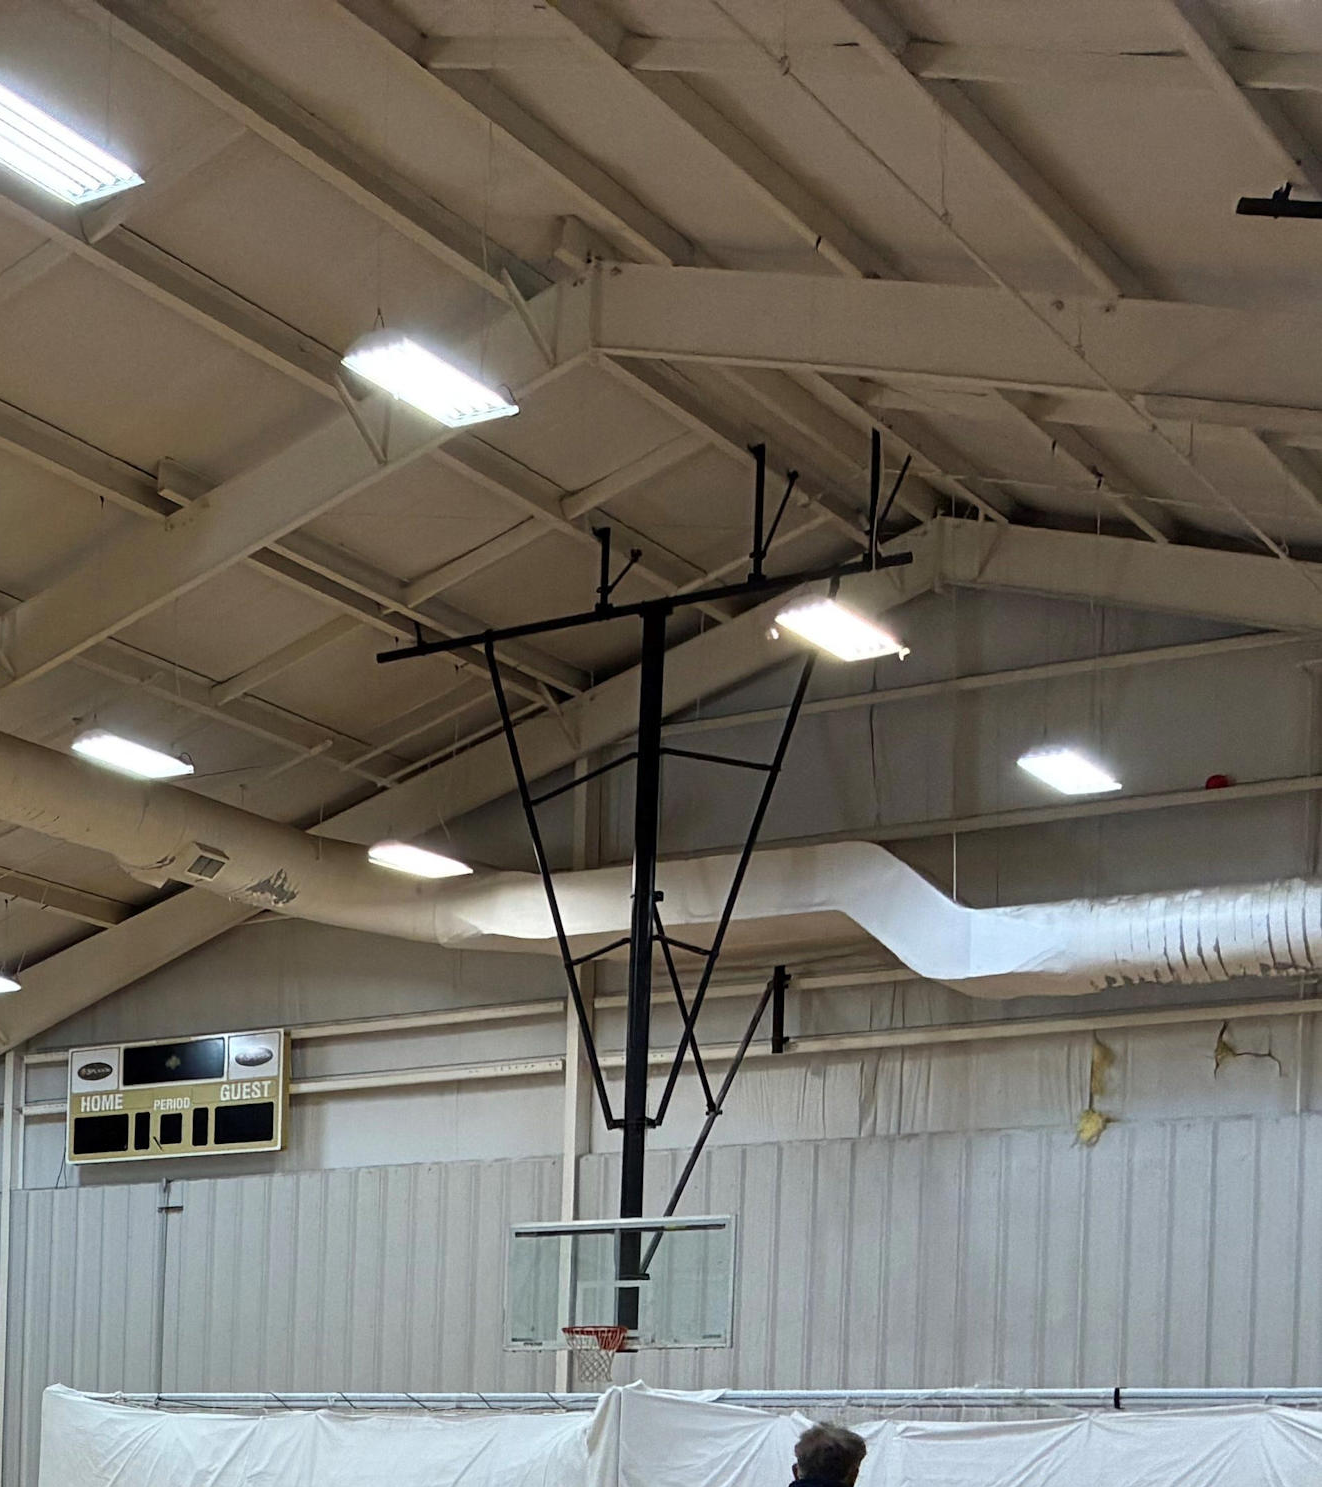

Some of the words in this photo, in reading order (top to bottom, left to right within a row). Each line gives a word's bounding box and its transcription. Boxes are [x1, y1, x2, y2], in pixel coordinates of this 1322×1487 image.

[220, 1080, 272, 1101] GUEST
[80, 1093, 123, 1112] HOME
[153, 1097, 191, 1111] PERIOD
